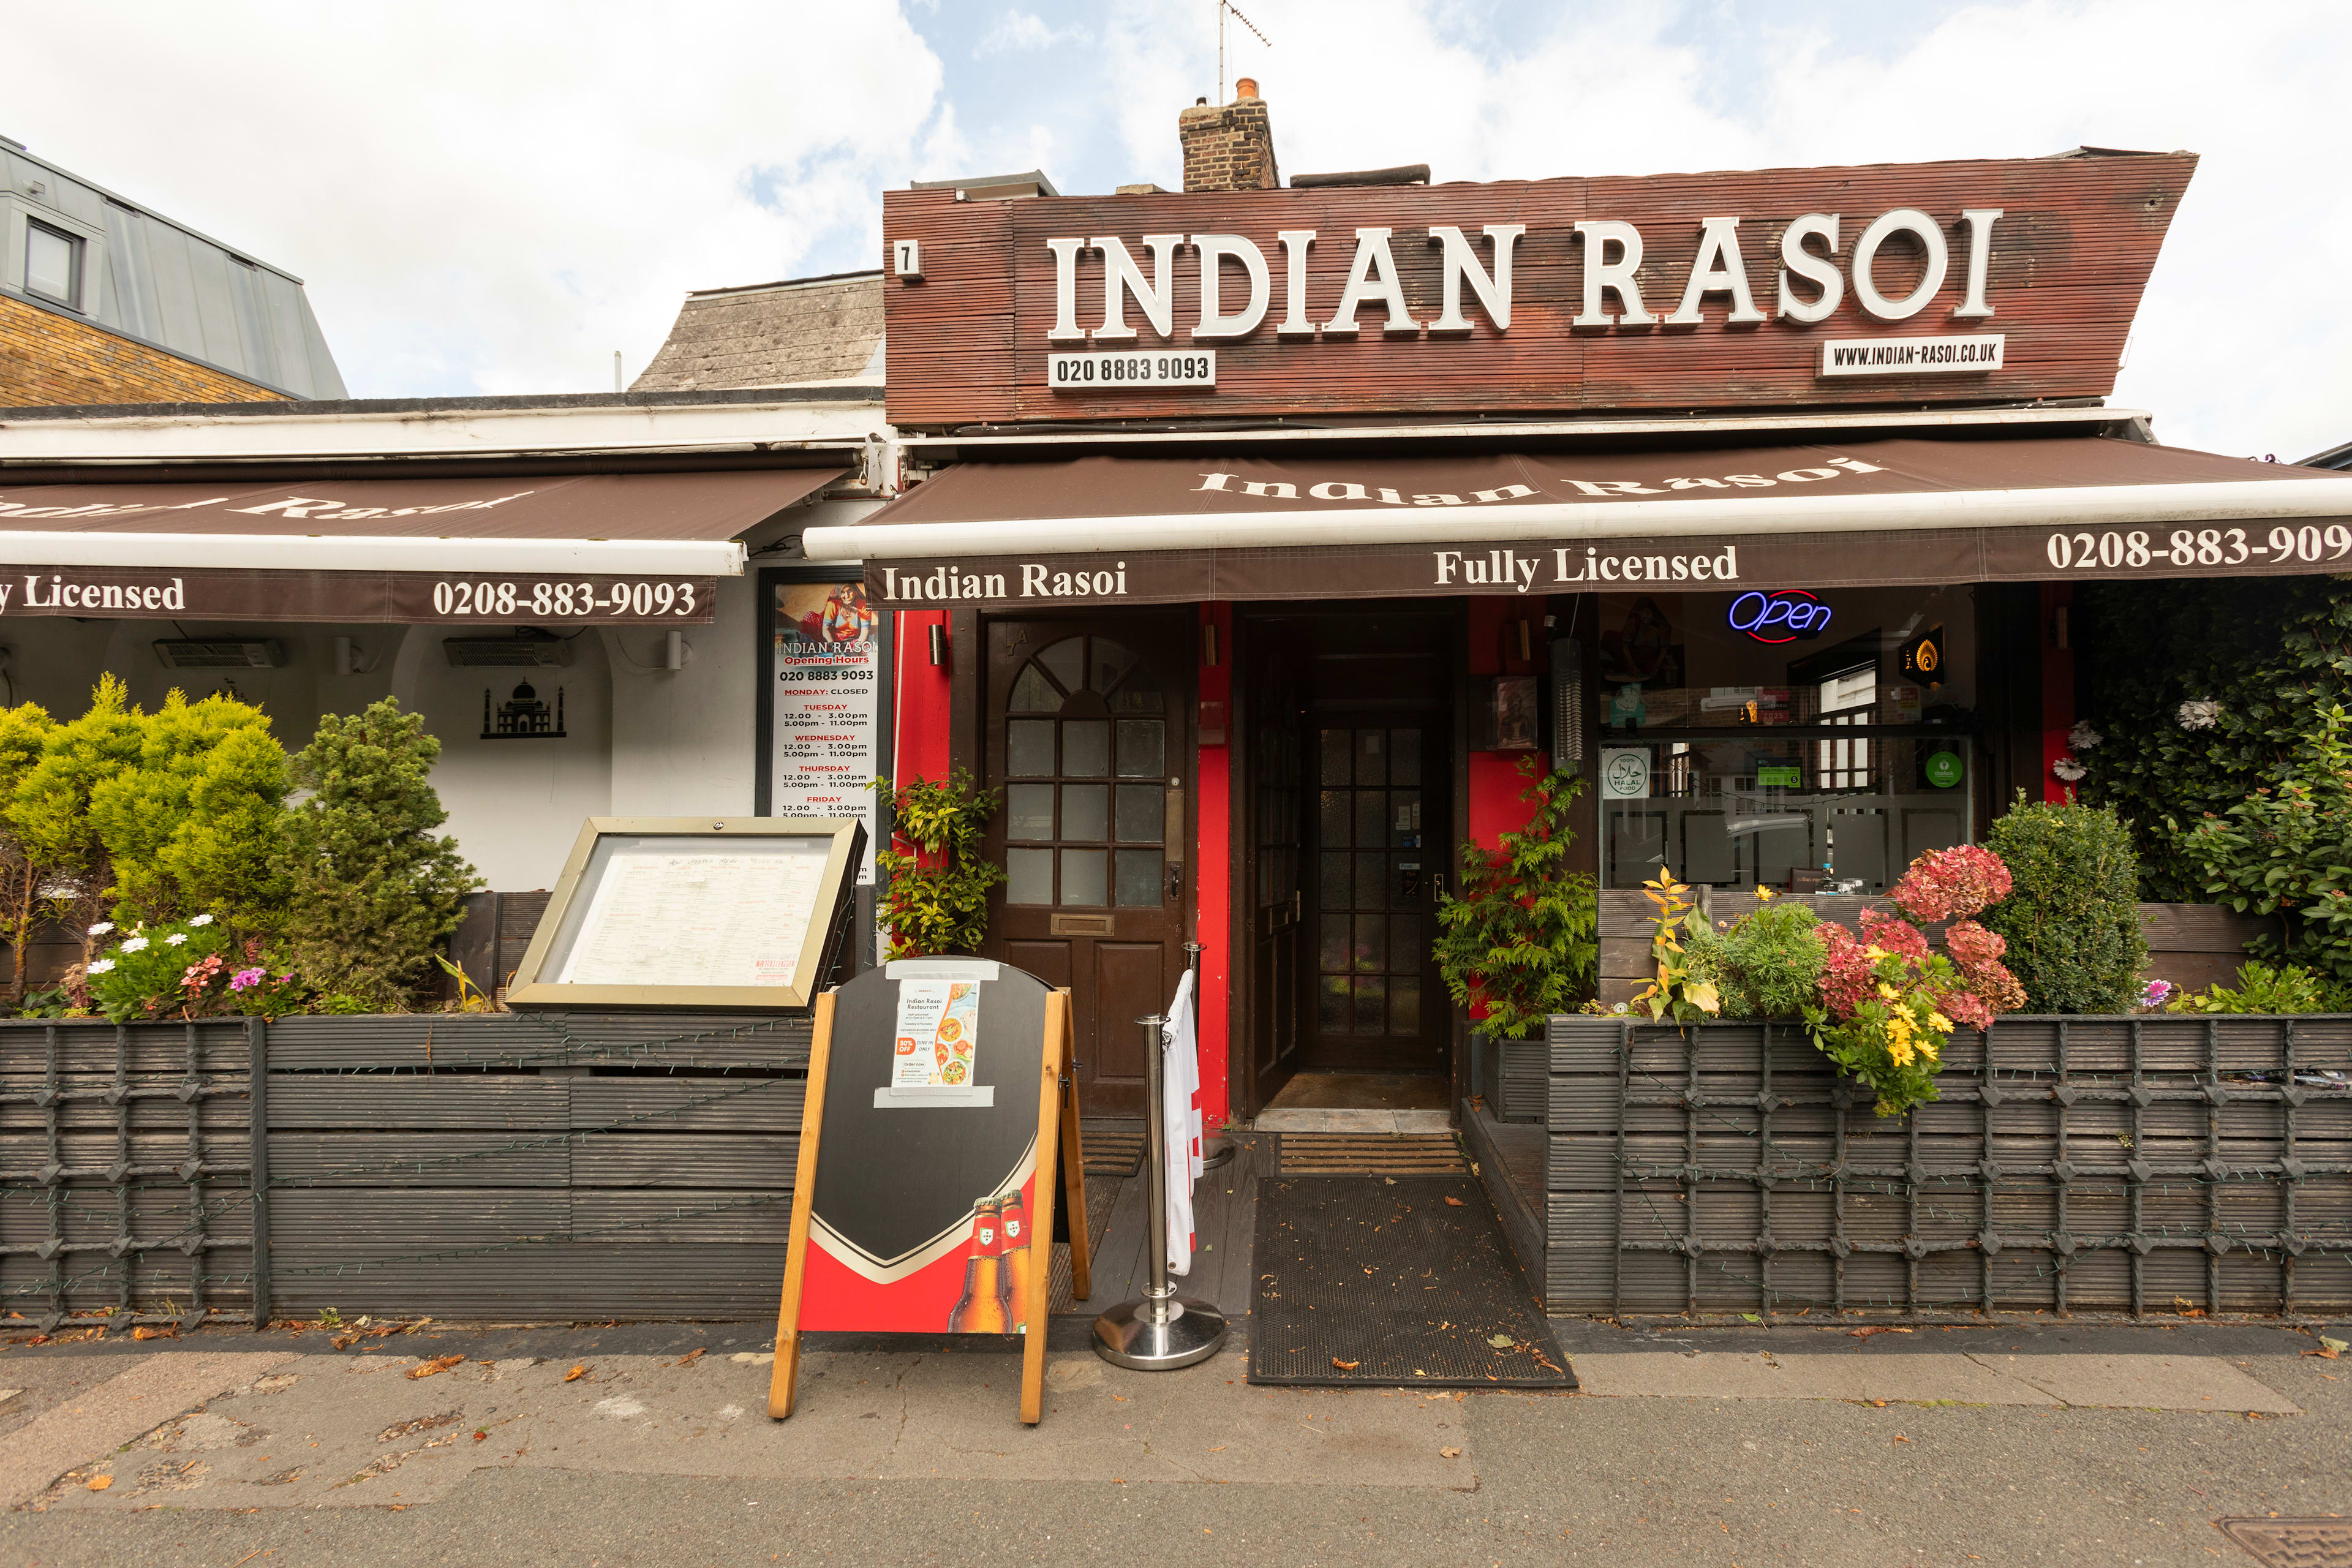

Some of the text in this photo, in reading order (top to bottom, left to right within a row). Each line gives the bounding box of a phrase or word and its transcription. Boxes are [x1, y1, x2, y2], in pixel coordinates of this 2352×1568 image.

[902, 246, 910, 271] 7
[1047, 208, 2003, 339] INDIAN RASOI
[1057, 357, 1209, 381] 020 8883 9093
[1834, 343, 1997, 366] WWW.INDIAN-RASOI.CO.UK
[1190, 456, 1891, 508] Indian Rasoi
[883, 561, 1128, 600] Indian Rasoi
[1433, 545, 1740, 593] Fully Licensed
[23, 575, 186, 610] Licensed
[434, 582, 695, 616] 0208-883-9093
[1729, 592, 1831, 631] Open
[778, 641, 877, 654] INDIAN RASOI
[785, 655, 869, 665] Opening Hours
[780, 670, 873, 681] 020 8883 9093
